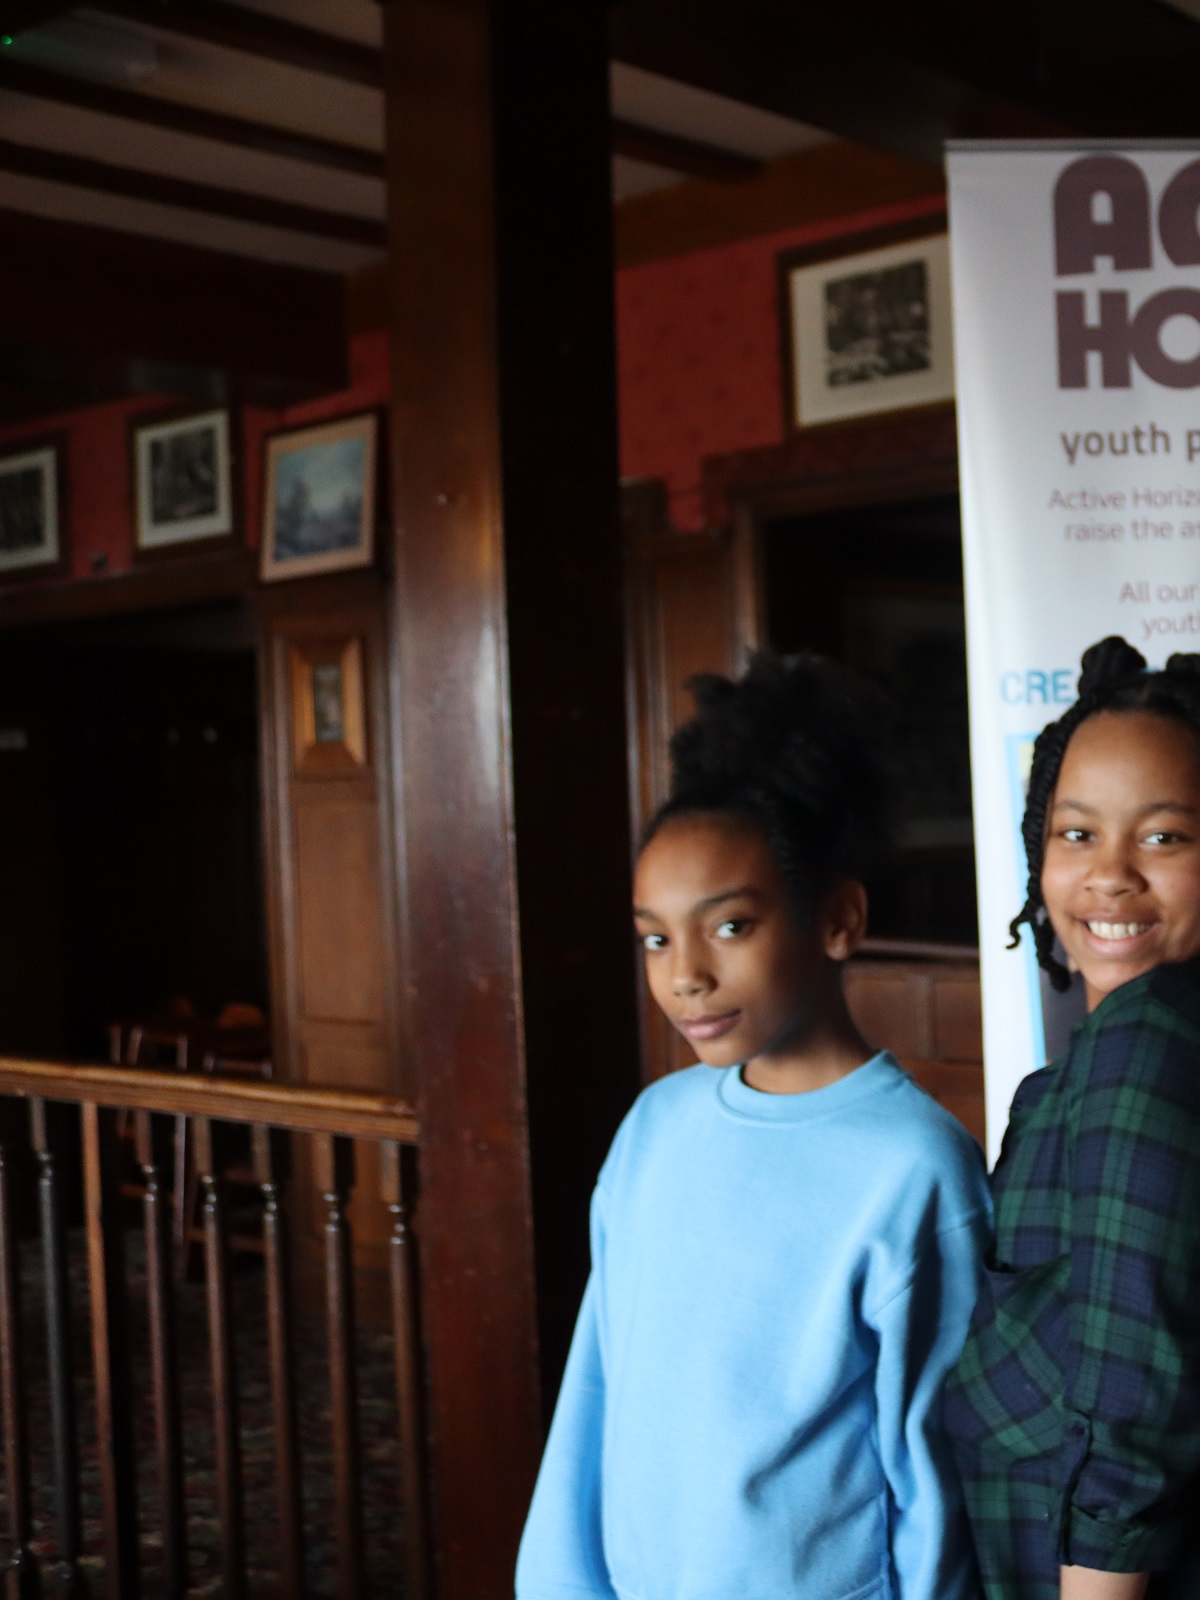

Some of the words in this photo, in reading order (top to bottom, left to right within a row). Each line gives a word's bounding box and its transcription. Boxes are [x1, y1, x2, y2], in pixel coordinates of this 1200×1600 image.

[1060, 421, 1171, 466] youth
[1050, 487, 1127, 509] Active
[1064, 517, 1125, 542] raise
[1131, 518, 1173, 541] the
[1119, 580, 1150, 602] All
[1156, 582, 1196, 602] our
